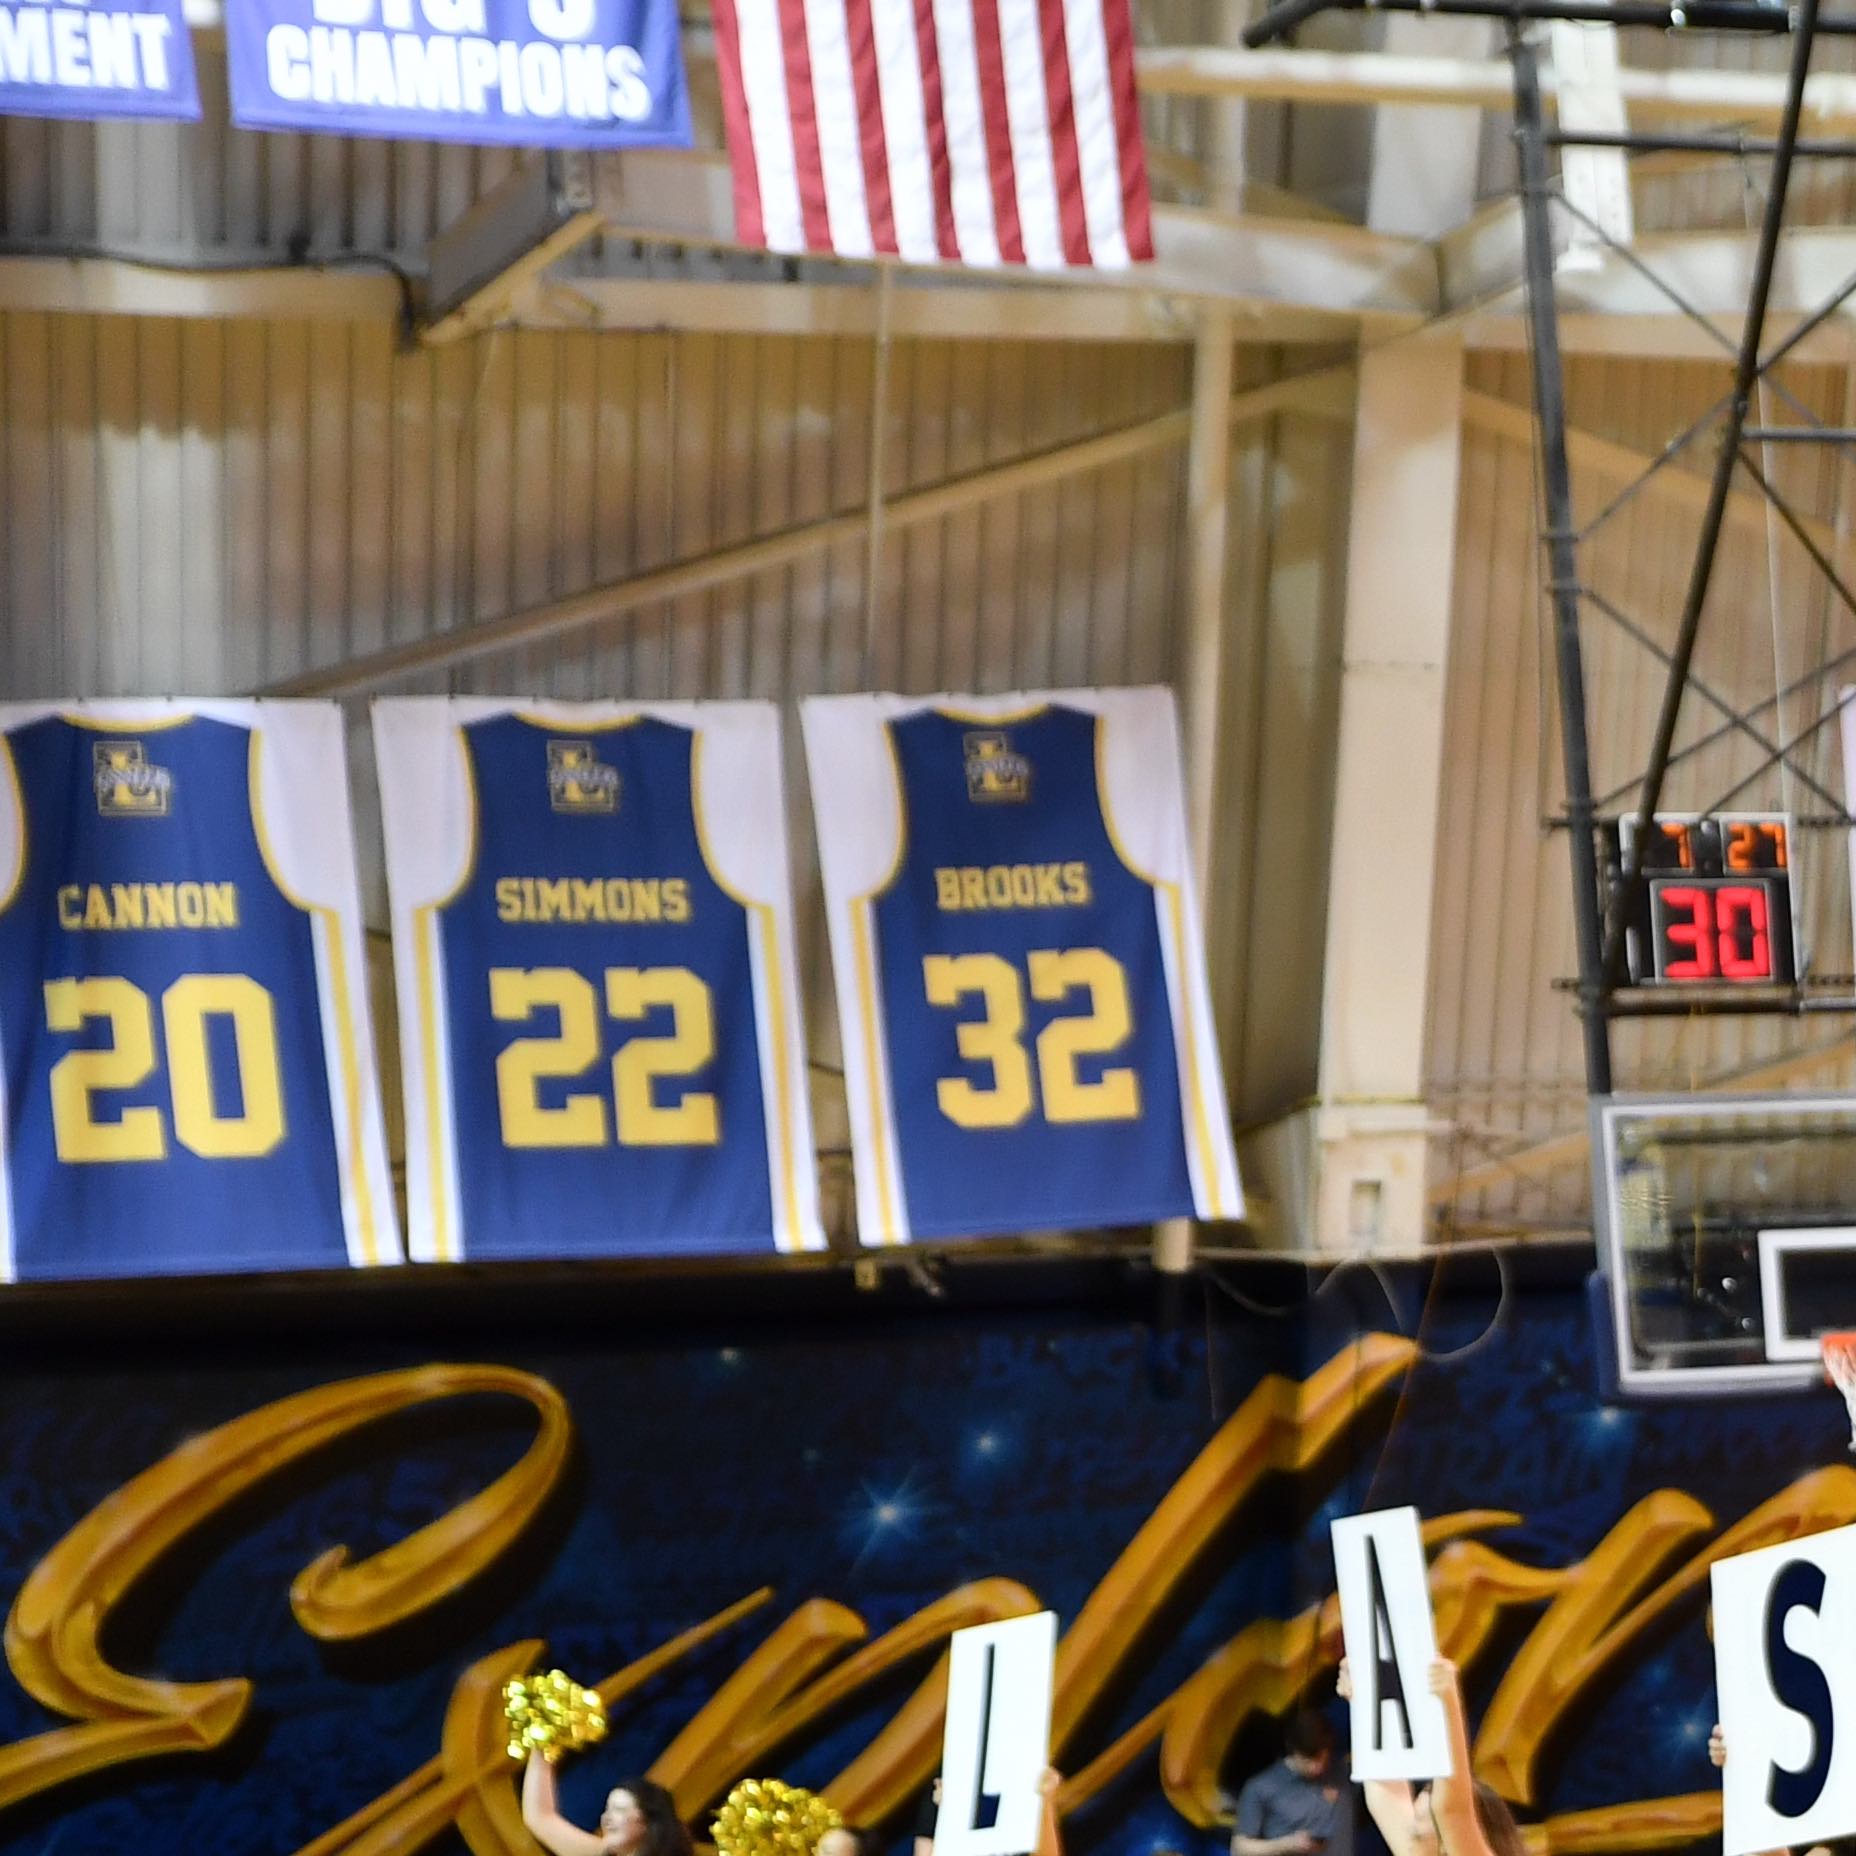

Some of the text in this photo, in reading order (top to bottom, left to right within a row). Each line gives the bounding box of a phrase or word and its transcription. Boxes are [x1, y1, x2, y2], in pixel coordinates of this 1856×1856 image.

[264, 22, 652, 122] CHAMPIONS
[56, 880, 238, 930] CANNON
[495, 877, 692, 924] SIMMONS
[934, 861, 1092, 911] BROOKS
[1659, 886, 1771, 978] 30
[43, 972, 284, 1164] 20
[488, 965, 720, 1148] 22
[923, 946, 1142, 1128] 32
[972, 1642, 1002, 1830] L
[1363, 1533, 1416, 1751] A
[1764, 1558, 1836, 1820] S
